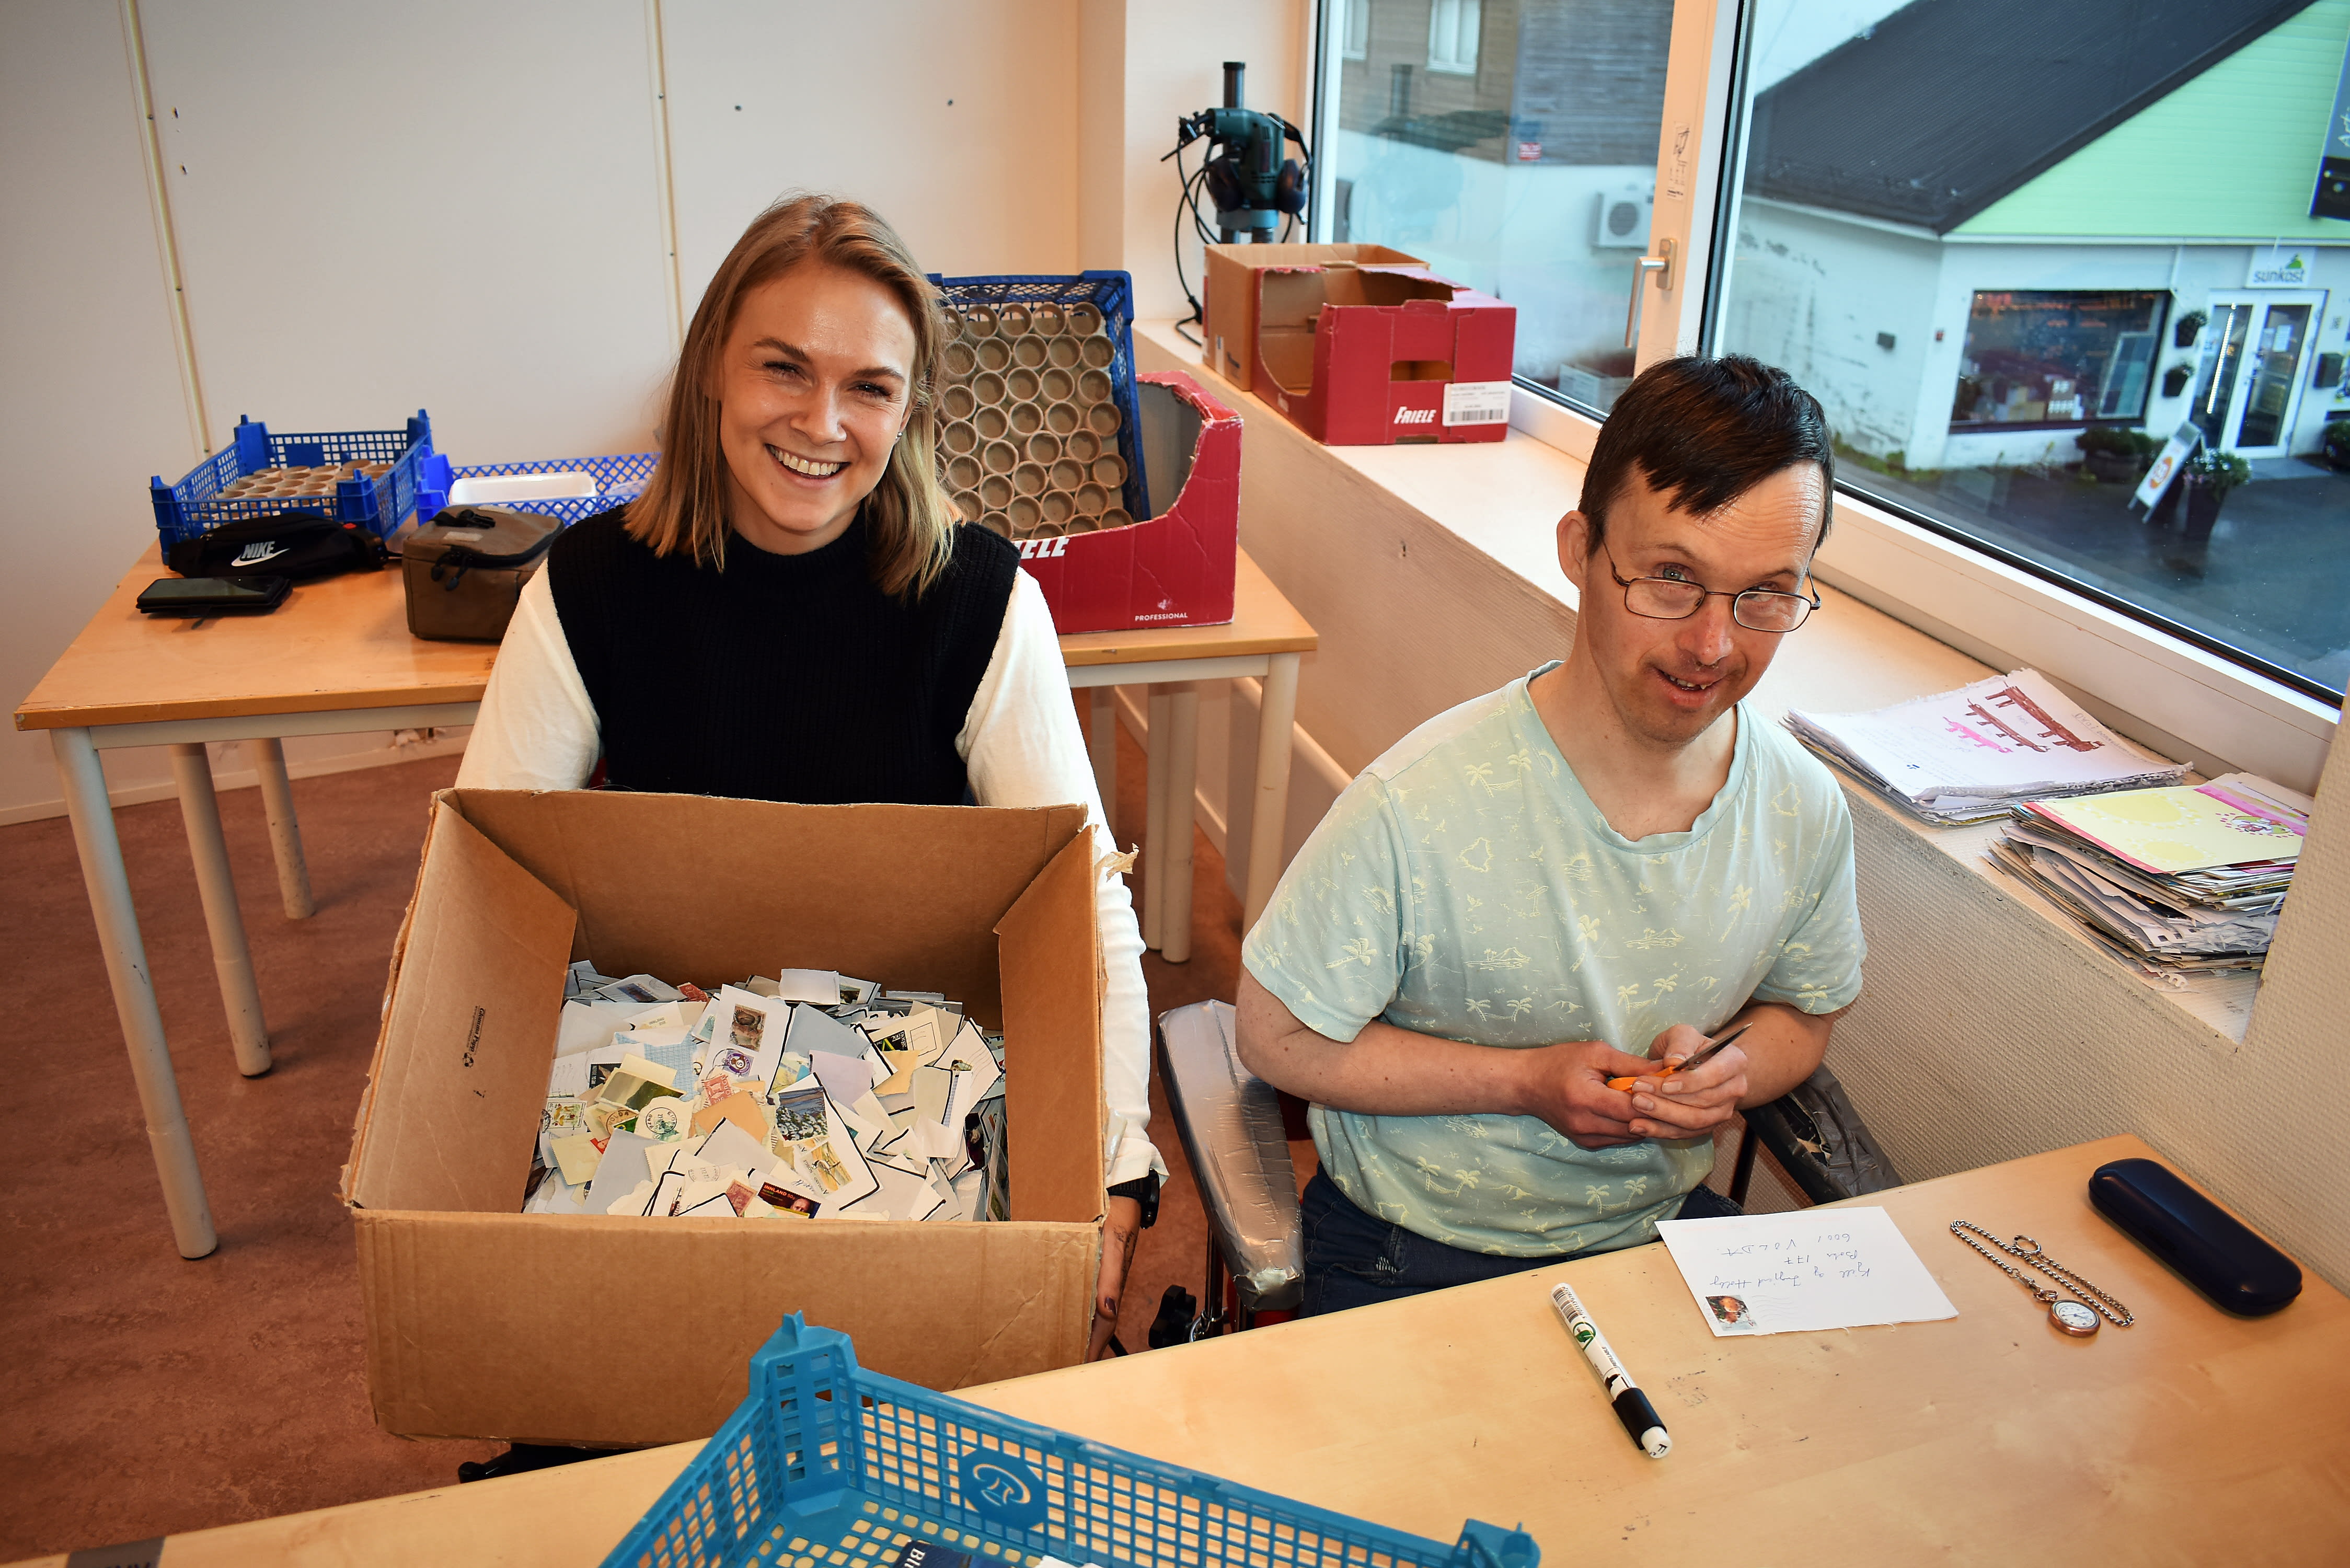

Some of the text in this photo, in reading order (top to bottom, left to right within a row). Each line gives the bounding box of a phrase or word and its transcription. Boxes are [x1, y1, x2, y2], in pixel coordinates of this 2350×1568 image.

[2253, 268, 2305, 283] sunkost
[1393, 406, 1437, 424] FRIELE
[240, 540, 276, 559] NIKE
[1134, 613, 1188, 621] PROFESSIONAL
[763, 1184, 787, 1196] INNLAND
[1783, 1254, 1809, 1265] 177
